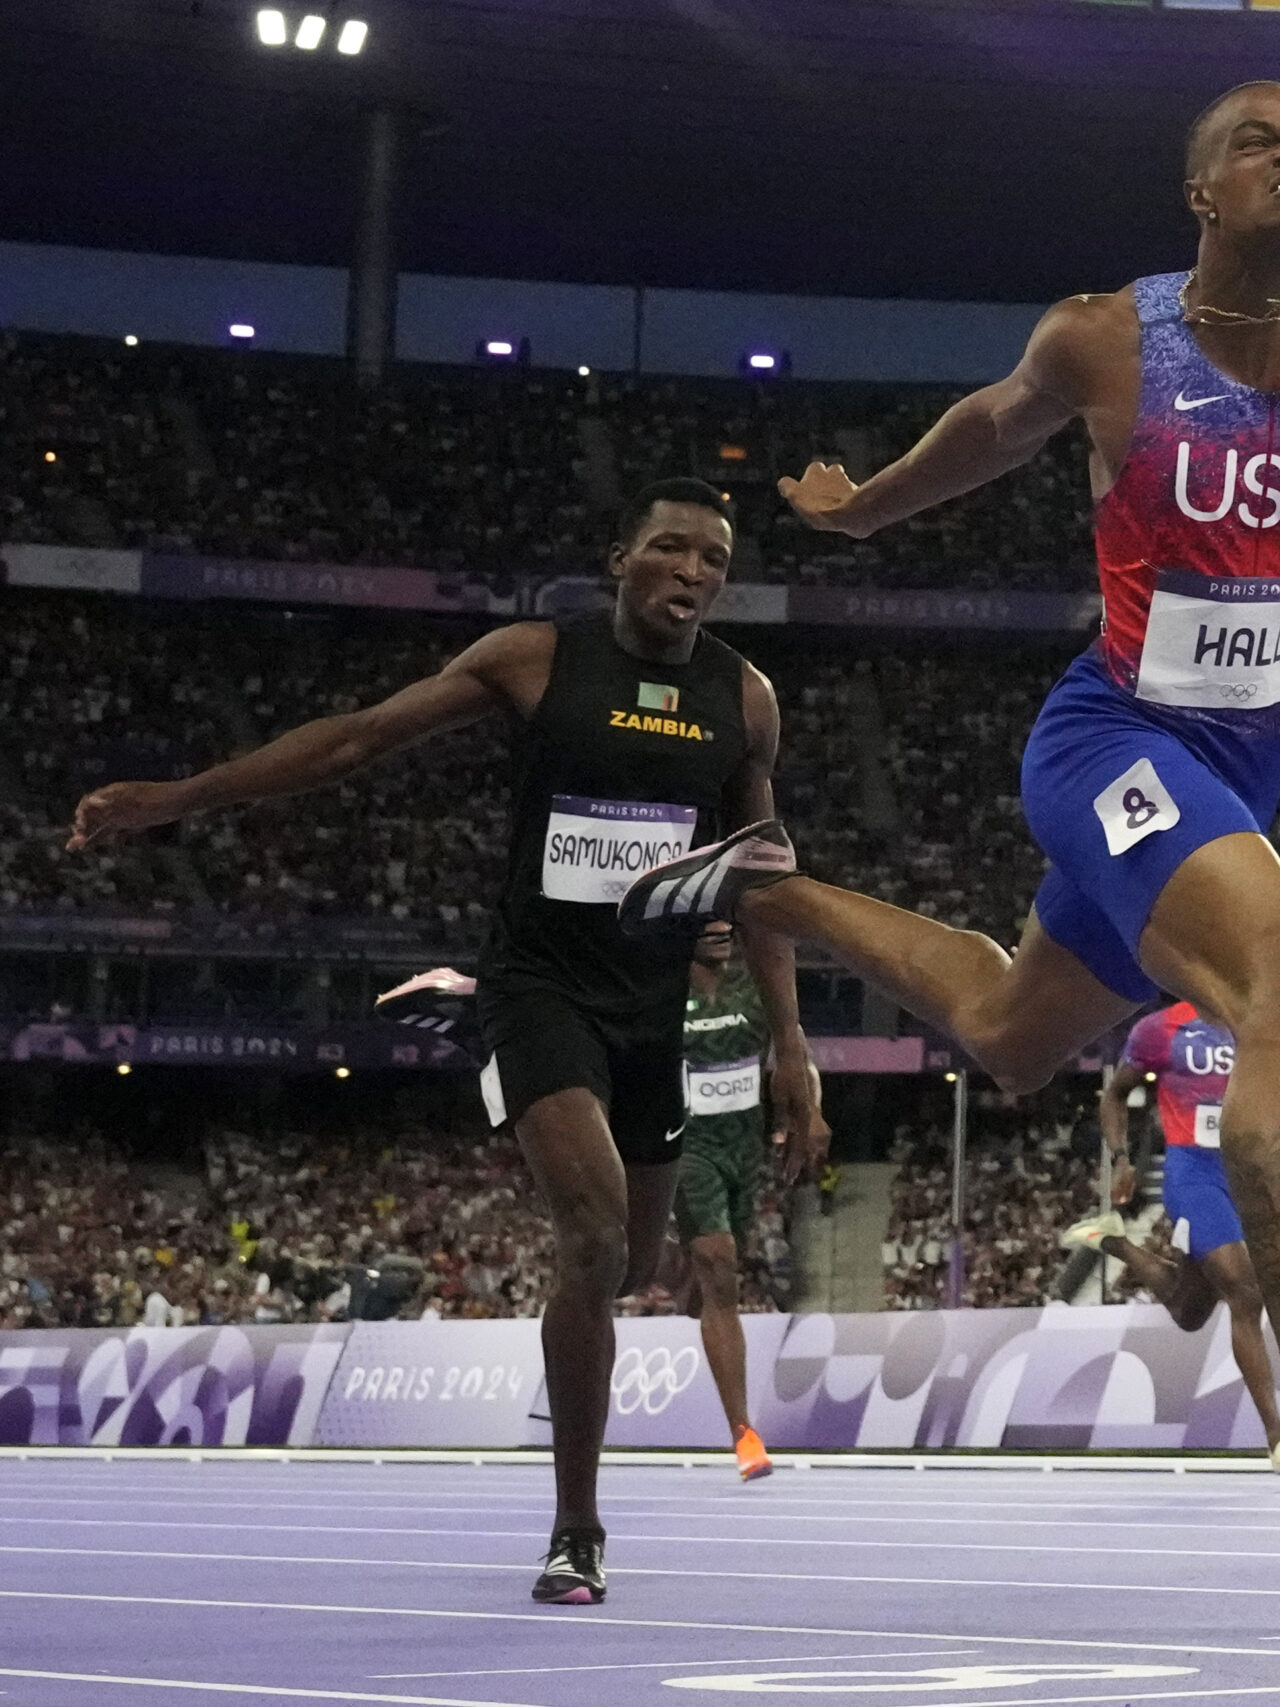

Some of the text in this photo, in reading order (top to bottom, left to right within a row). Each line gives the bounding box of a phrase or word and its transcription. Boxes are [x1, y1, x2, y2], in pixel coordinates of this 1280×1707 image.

[1209, 582, 1256, 596] PARIS
[609, 710, 703, 741] ZAMBIA
[590, 803, 663, 818] PARIS 2024
[1122, 787, 1160, 829] 8
[1185, 1045, 1235, 1075] US
[345, 1366, 524, 1400] PARIS 2024
